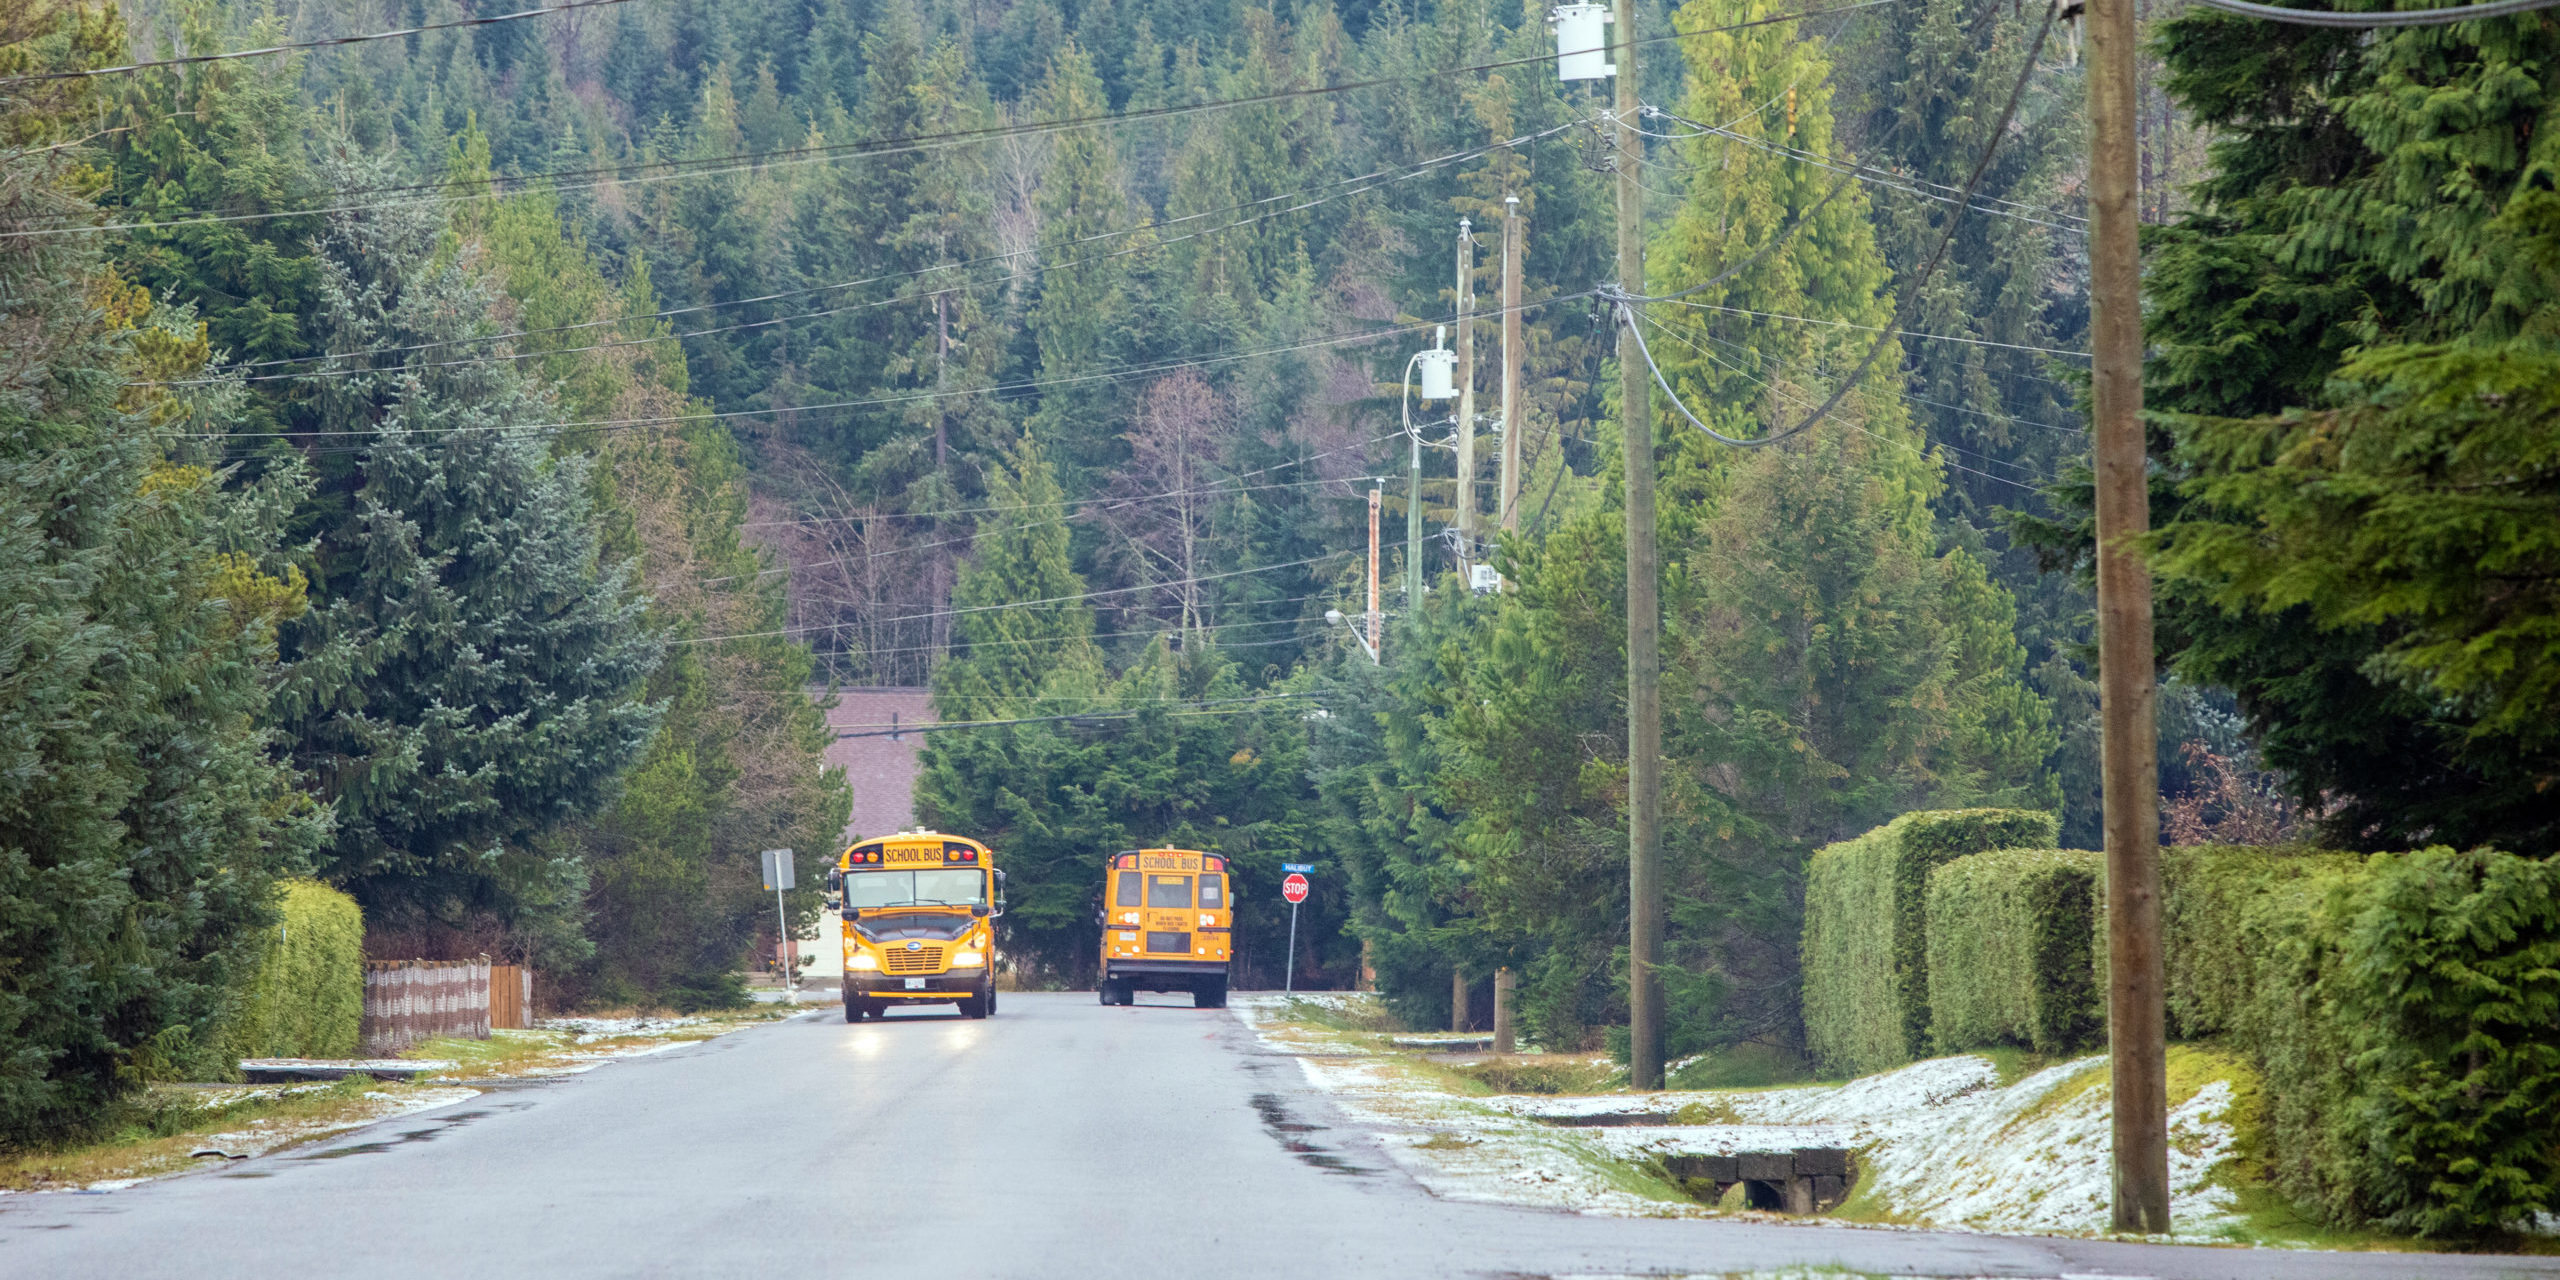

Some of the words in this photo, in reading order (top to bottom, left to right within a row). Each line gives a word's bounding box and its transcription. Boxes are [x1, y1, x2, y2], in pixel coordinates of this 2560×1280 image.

[885, 847, 921, 862] SCHOOL
[923, 847, 942, 861] BUS
[1143, 856, 1177, 869] SCHOOL
[1181, 857, 1199, 870] BUS
[1284, 882, 1307, 895] STOP
